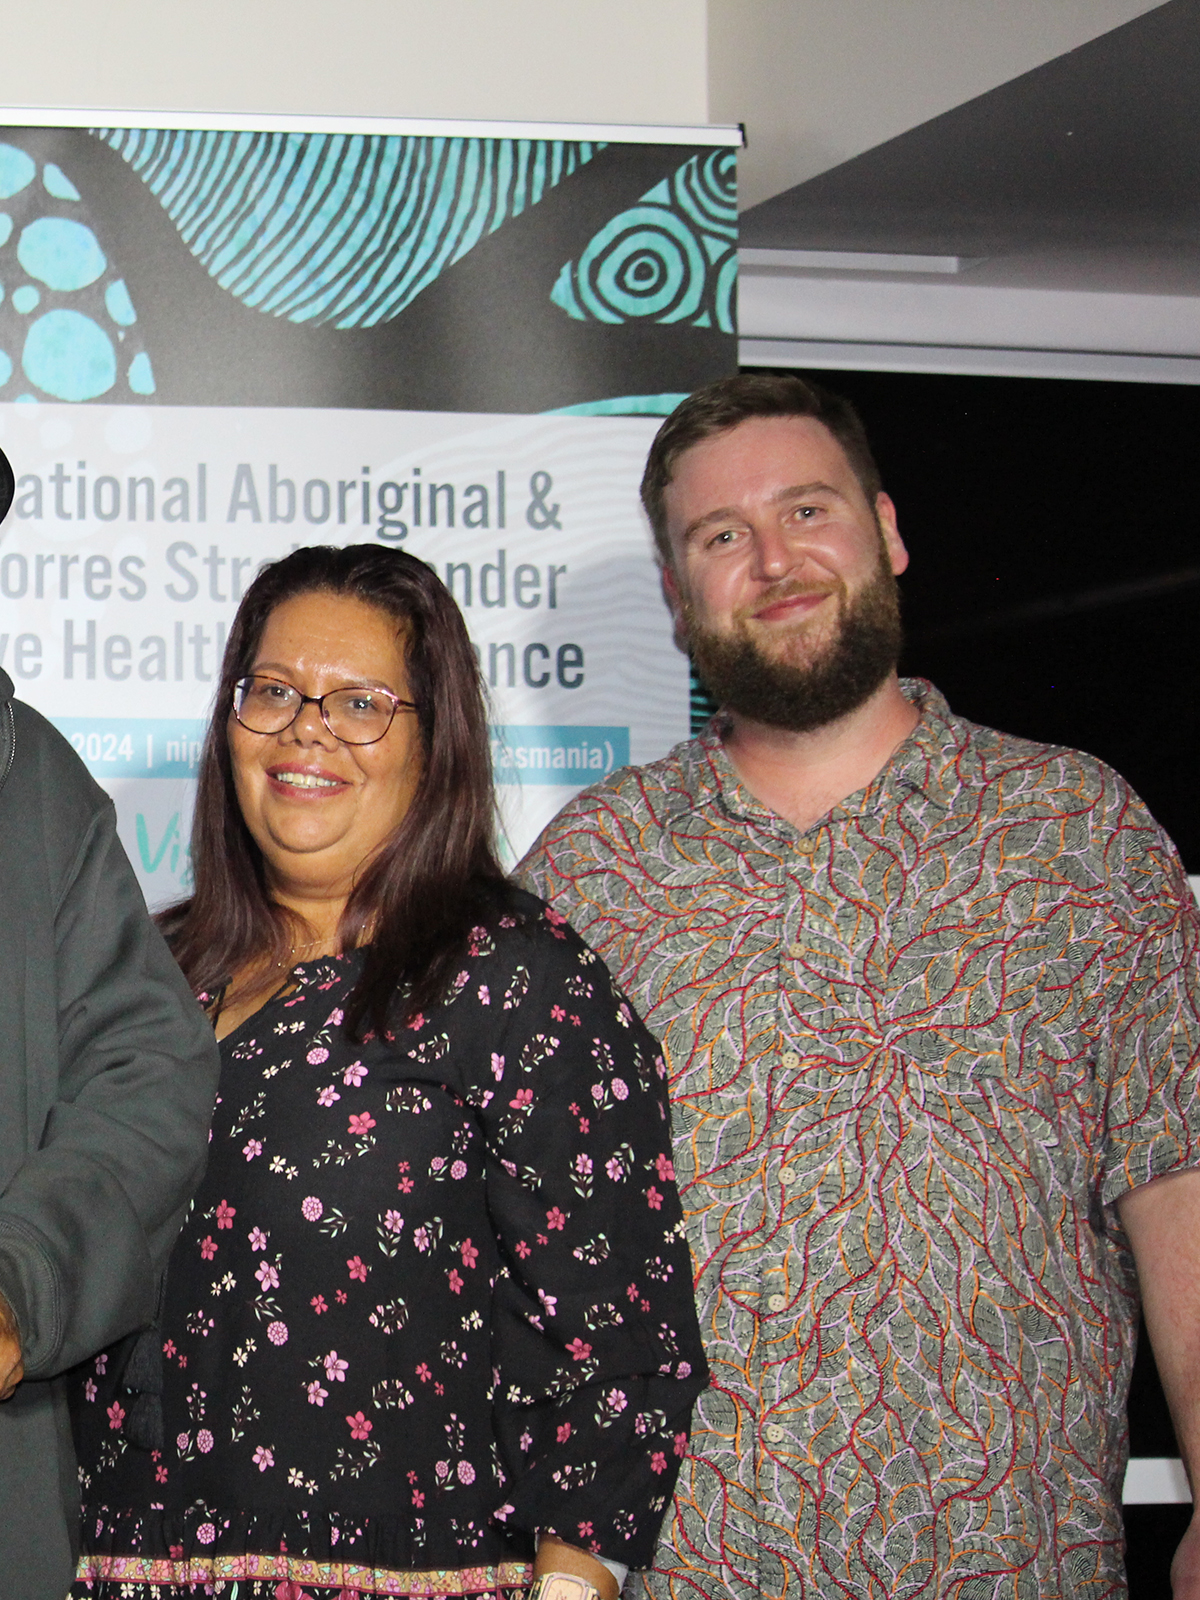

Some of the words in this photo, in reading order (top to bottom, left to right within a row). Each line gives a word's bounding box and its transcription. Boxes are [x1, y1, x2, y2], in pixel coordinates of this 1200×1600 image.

[14, 460, 207, 523] ational
[226, 463, 506, 542] Aboriginal
[525, 470, 563, 531] &
[70, 732, 135, 762] 2024
[490, 740, 615, 774] Tasmania)
